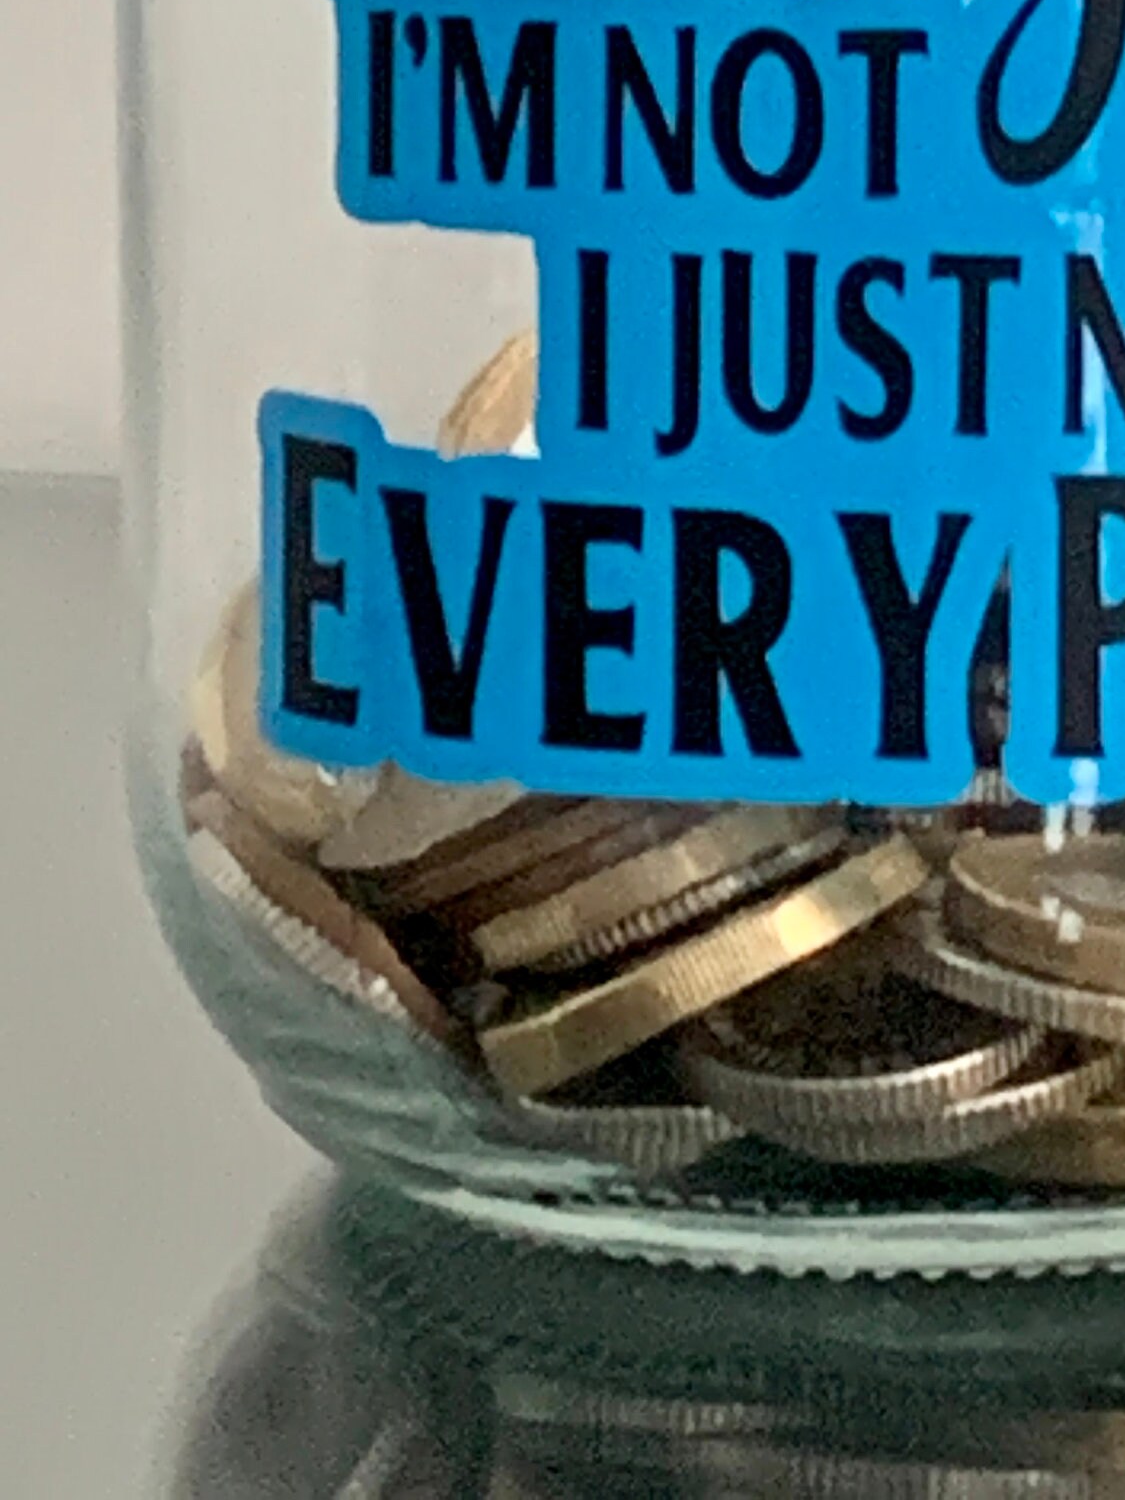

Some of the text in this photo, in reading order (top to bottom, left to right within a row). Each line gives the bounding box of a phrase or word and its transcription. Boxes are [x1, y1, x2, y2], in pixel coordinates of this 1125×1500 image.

[366, 10, 557, 188] I'M
[603, 26, 929, 199] NOT
[576, 250, 609, 431] I
[656, 250, 1020, 456] JUST
[279, 433, 973, 760] EVERY
